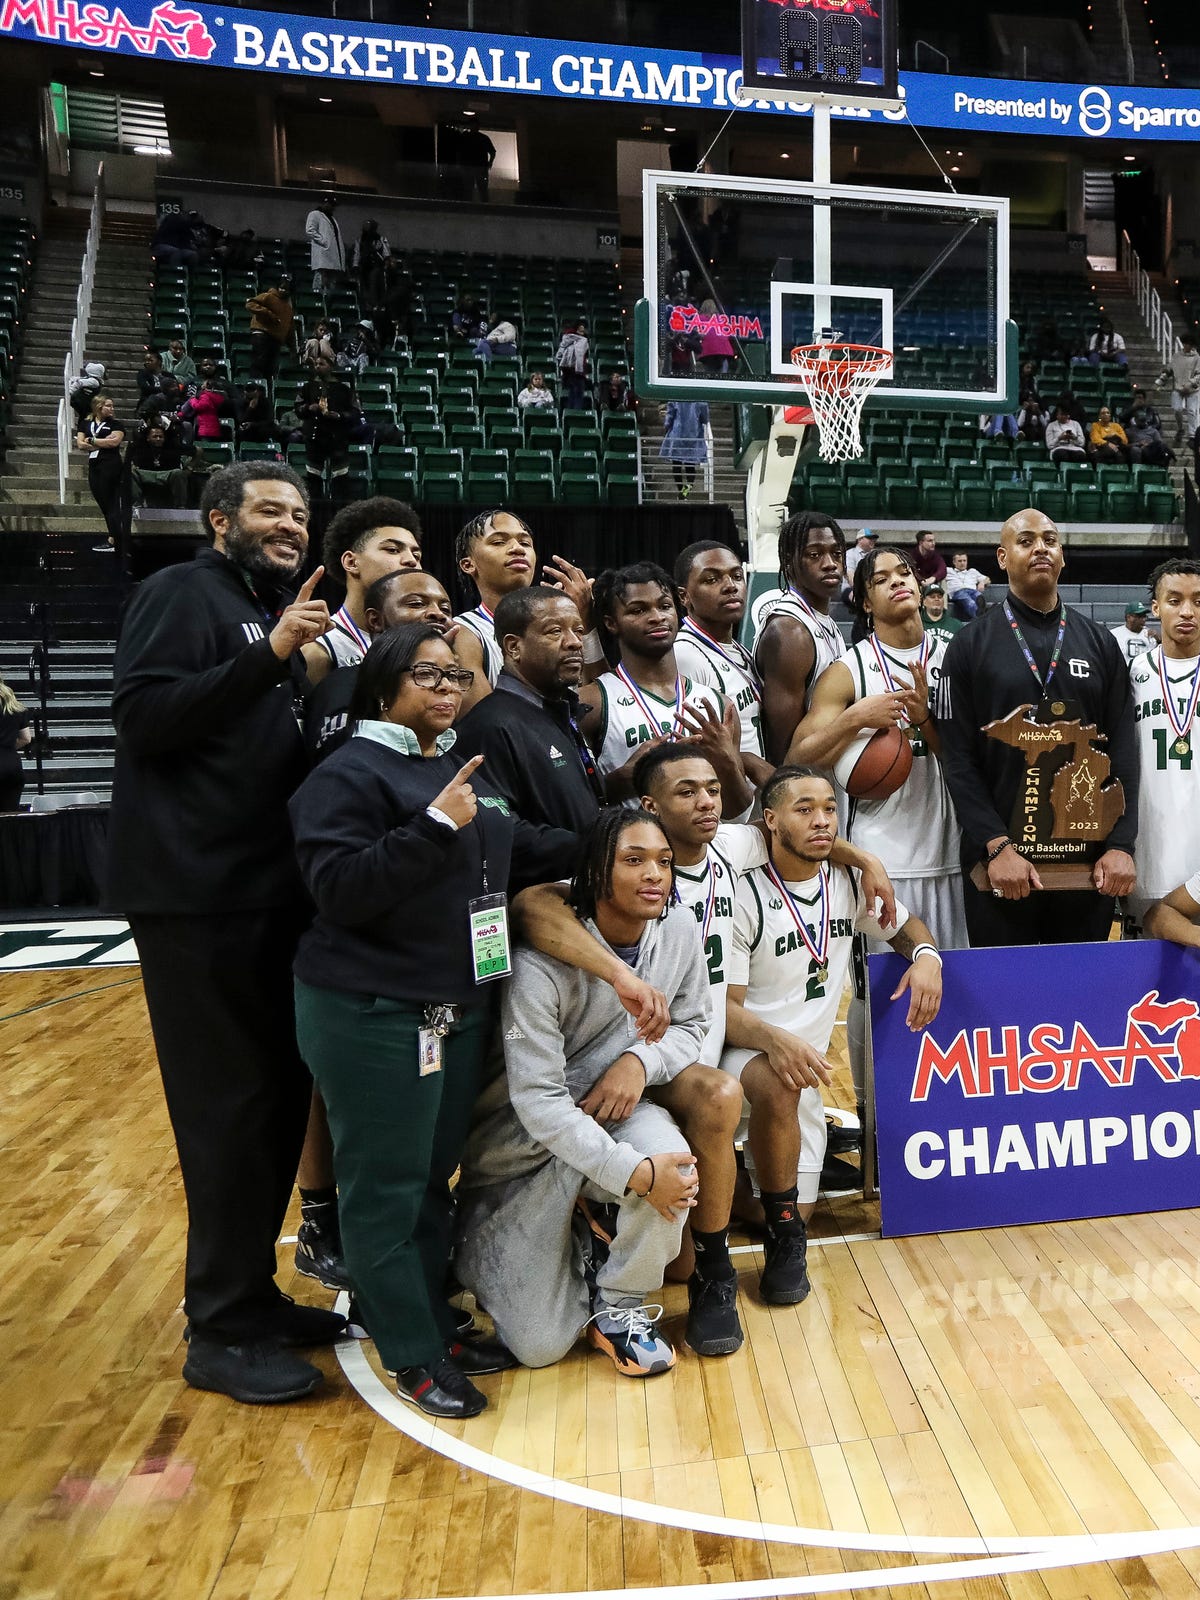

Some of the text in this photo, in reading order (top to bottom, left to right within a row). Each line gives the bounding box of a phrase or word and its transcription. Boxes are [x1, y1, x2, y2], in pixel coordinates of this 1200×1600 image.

[233, 23, 906, 121] BASKETBALL CHAMPIO
[954, 93, 1072, 125] Presented by
[159, 203, 181, 215] 135
[599, 235, 617, 246] 101
[736, 686, 757, 711] CAS
[625, 721, 672, 748] CAS
[1152, 728, 1193, 770] 14
[1022, 767, 1041, 842] CHAMPION
[1069, 822, 1099, 830] 2023
[1013, 843, 1086, 854] Boys Basketball
[819, 918, 853, 938] ECH
[804, 956, 829, 1003] 2
[909, 1016, 1182, 1103] MHSAA
